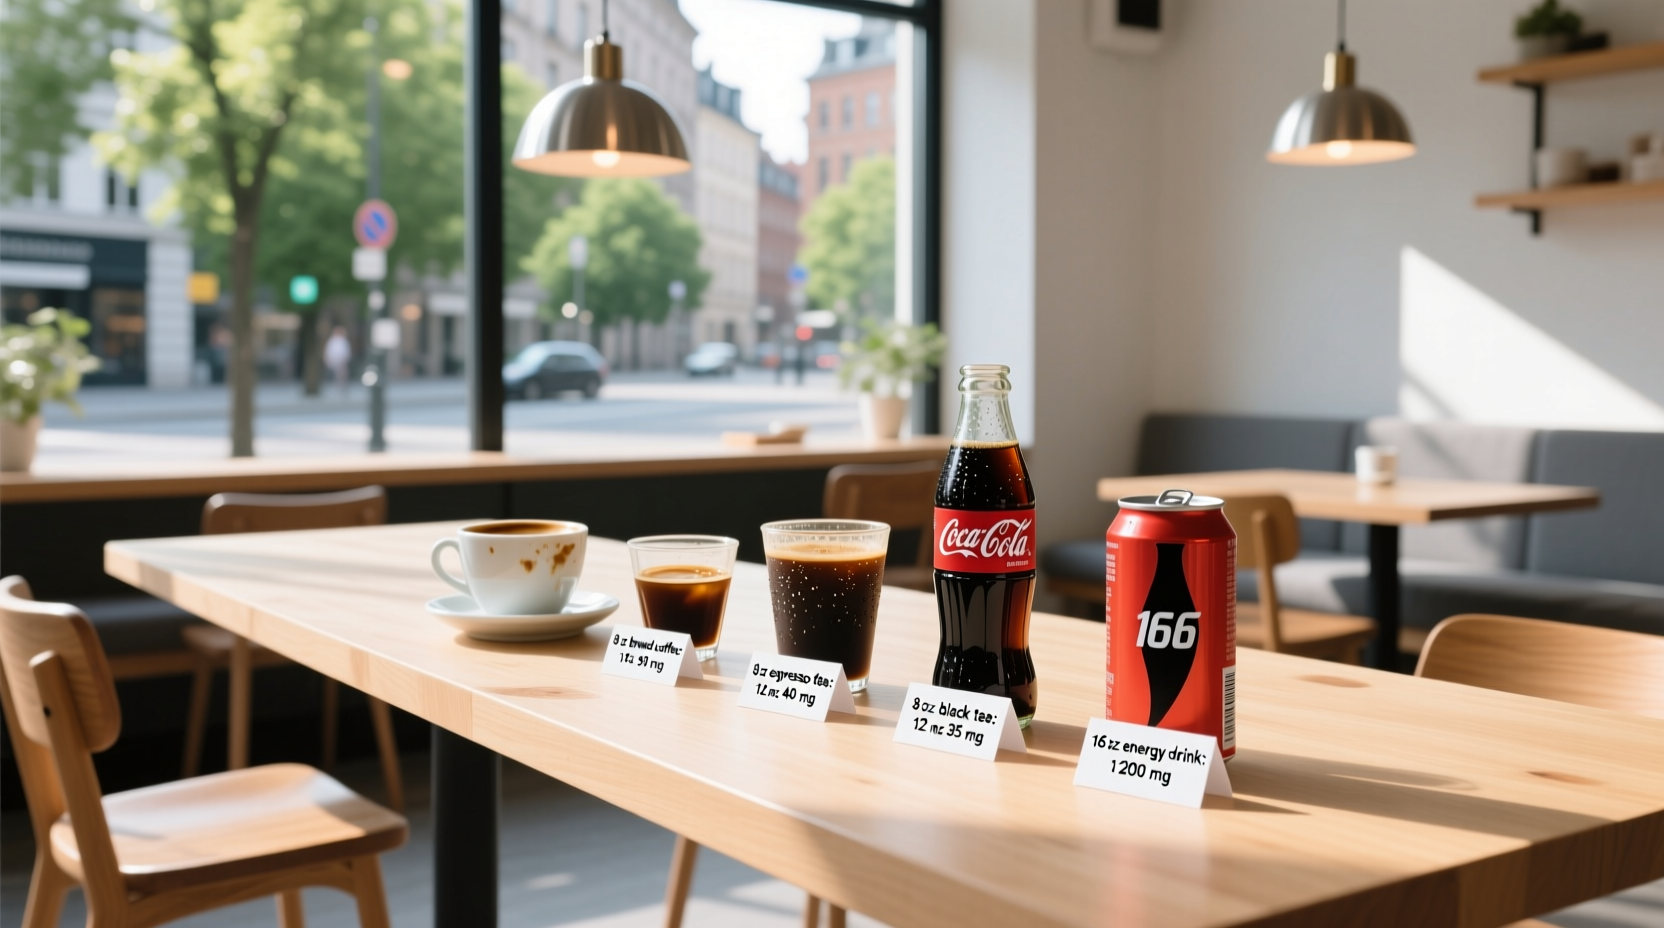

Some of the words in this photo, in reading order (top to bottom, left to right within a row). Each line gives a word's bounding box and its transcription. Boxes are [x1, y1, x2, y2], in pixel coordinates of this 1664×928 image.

[939, 518, 1032, 558] Coca-Cola
[1136, 611, 1201, 650] 166
[782, 686, 797, 700] 40
[799, 693, 816, 708] mg
[912, 697, 920, 710] 8
[938, 701, 971, 720] black
[913, 717, 928, 732] 12
[946, 723, 963, 738] 35
[964, 731, 984, 747] mg
[1092, 735, 1107, 748] 16
[1122, 742, 1166, 762] energy
[1168, 745, 1207, 765] drink:
[1149, 769, 1172, 787] mg
